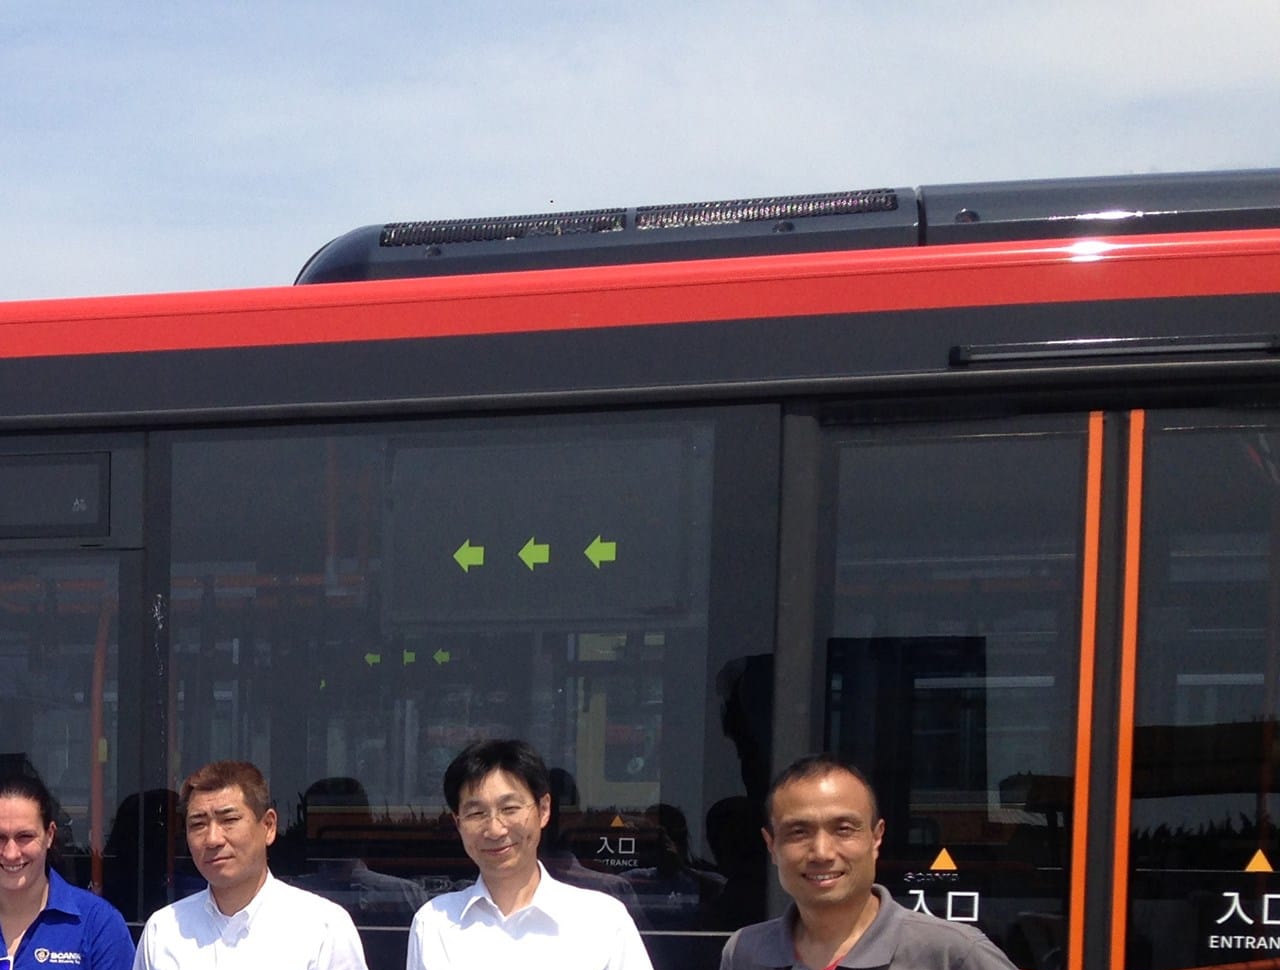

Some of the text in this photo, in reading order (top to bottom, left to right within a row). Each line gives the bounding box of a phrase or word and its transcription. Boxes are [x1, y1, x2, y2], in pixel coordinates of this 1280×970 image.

[597, 836, 635, 854] 入口
[596, 859, 638, 867] TRANCE
[909, 890, 979, 921] 入口
[1209, 935, 1280, 949] ENTRAN
